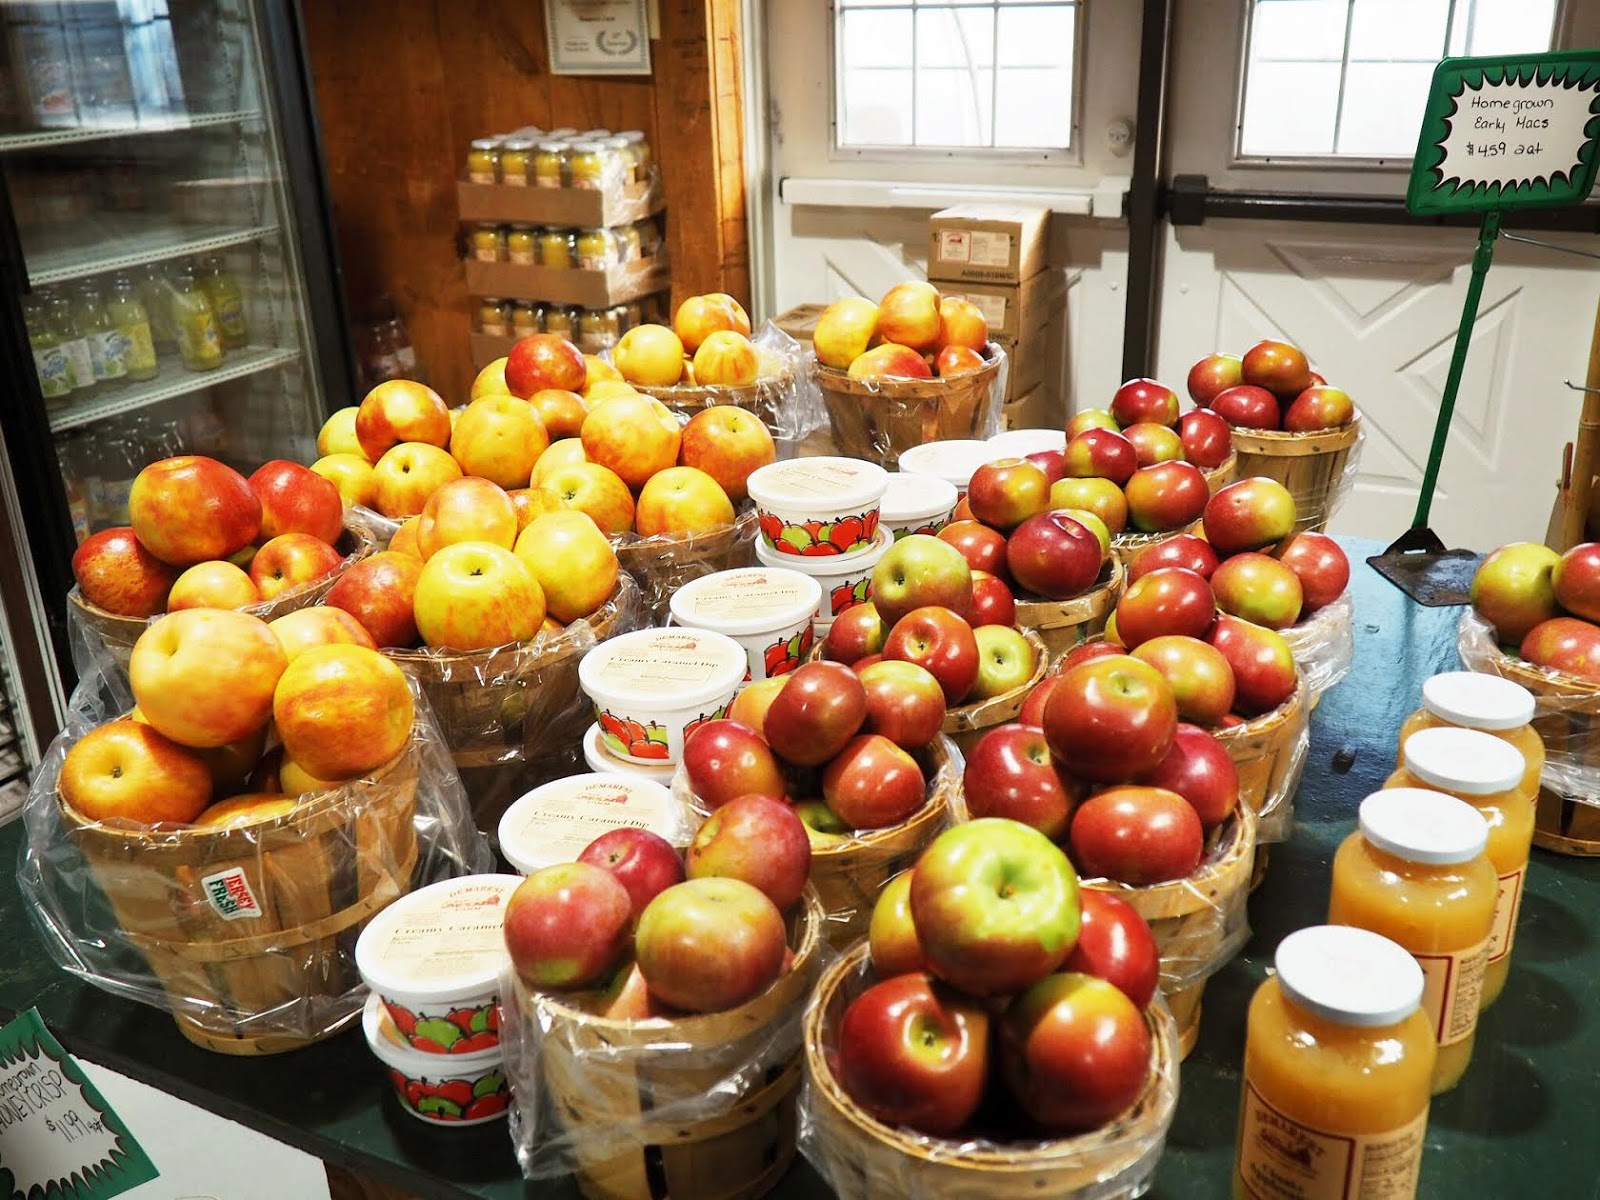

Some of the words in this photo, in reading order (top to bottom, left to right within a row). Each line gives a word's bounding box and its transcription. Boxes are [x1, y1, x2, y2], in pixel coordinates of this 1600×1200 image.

[1471, 96, 1554, 115] Homegrown
[1474, 116, 1506, 134] Early
[1515, 116, 1549, 130] Macs
[585, 783, 634, 794] DEMAREST
[534, 810, 575, 821] Creamy
[579, 814, 628, 826] Caramel
[630, 819, 650, 829] Dip
[208, 878, 241, 914] FRESH
[224, 874, 256, 910] JERSEY
[449, 885, 506, 899] DEMAREST
[394, 928, 443, 937] Creamy
